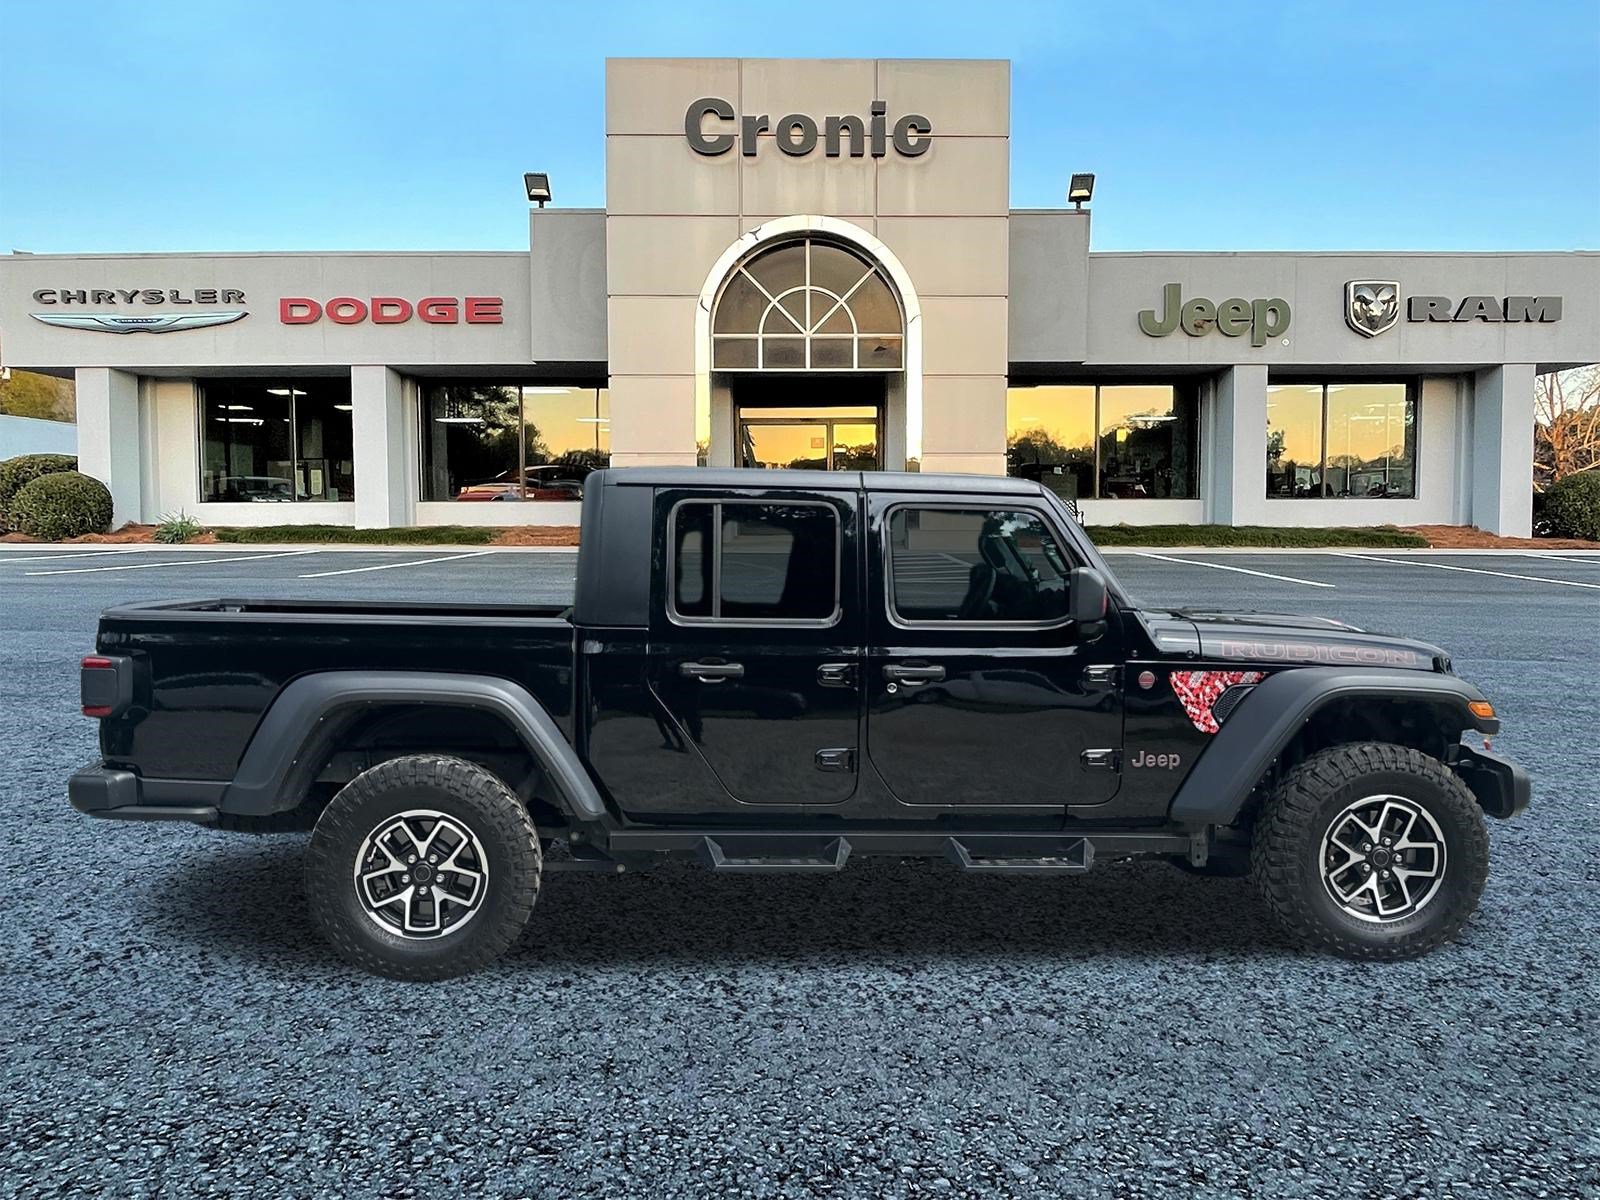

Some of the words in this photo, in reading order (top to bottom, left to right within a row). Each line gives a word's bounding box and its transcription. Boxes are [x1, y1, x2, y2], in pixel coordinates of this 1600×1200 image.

[685, 97, 932, 157] Cronic
[32, 289, 246, 304] CHRYSLER
[1407, 296, 1563, 322] RAM
[279, 297, 504, 325] DODGE
[1138, 283, 1292, 347] Jeep
[1221, 640, 1417, 666] RUBICON
[1131, 750, 1181, 769] Jeep
